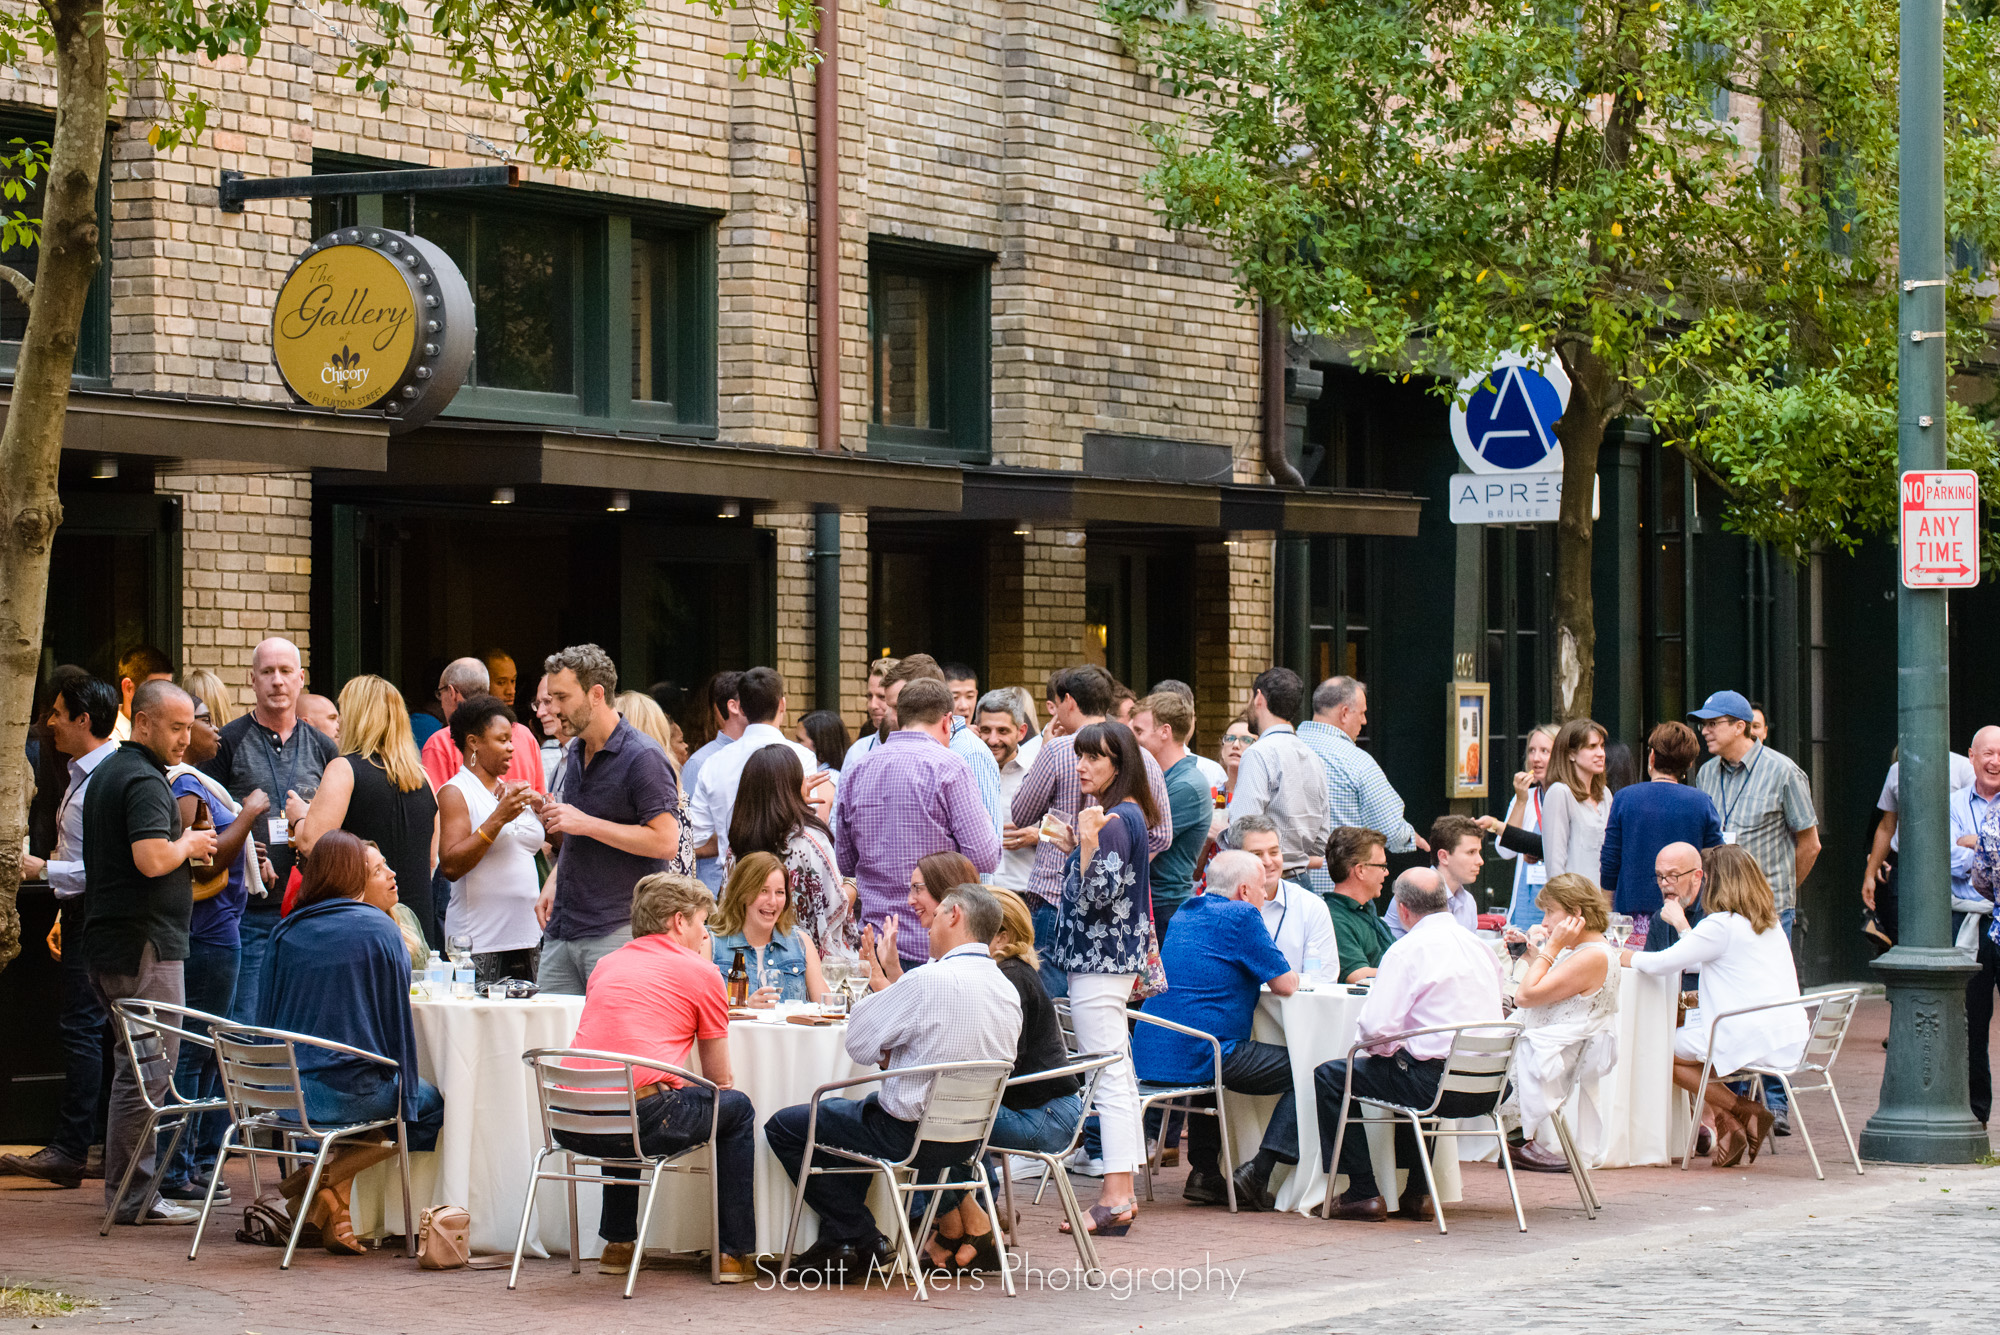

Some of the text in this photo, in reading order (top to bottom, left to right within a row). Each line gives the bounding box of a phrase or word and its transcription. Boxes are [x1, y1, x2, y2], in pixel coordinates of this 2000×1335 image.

[309, 263, 335, 283] The
[281, 284, 413, 351] Gallery
[338, 330, 353, 342] at
[321, 366, 370, 388] Chicory
[307, 386, 384, 408] 611 FULTON STREET
[1903, 481, 1972, 503] NO PARKING
[1487, 507, 1541, 518] BRULEE
[1918, 516, 1960, 537] ANY
[1916, 542, 1963, 562] TIME
[1456, 652, 1473, 677] 609
